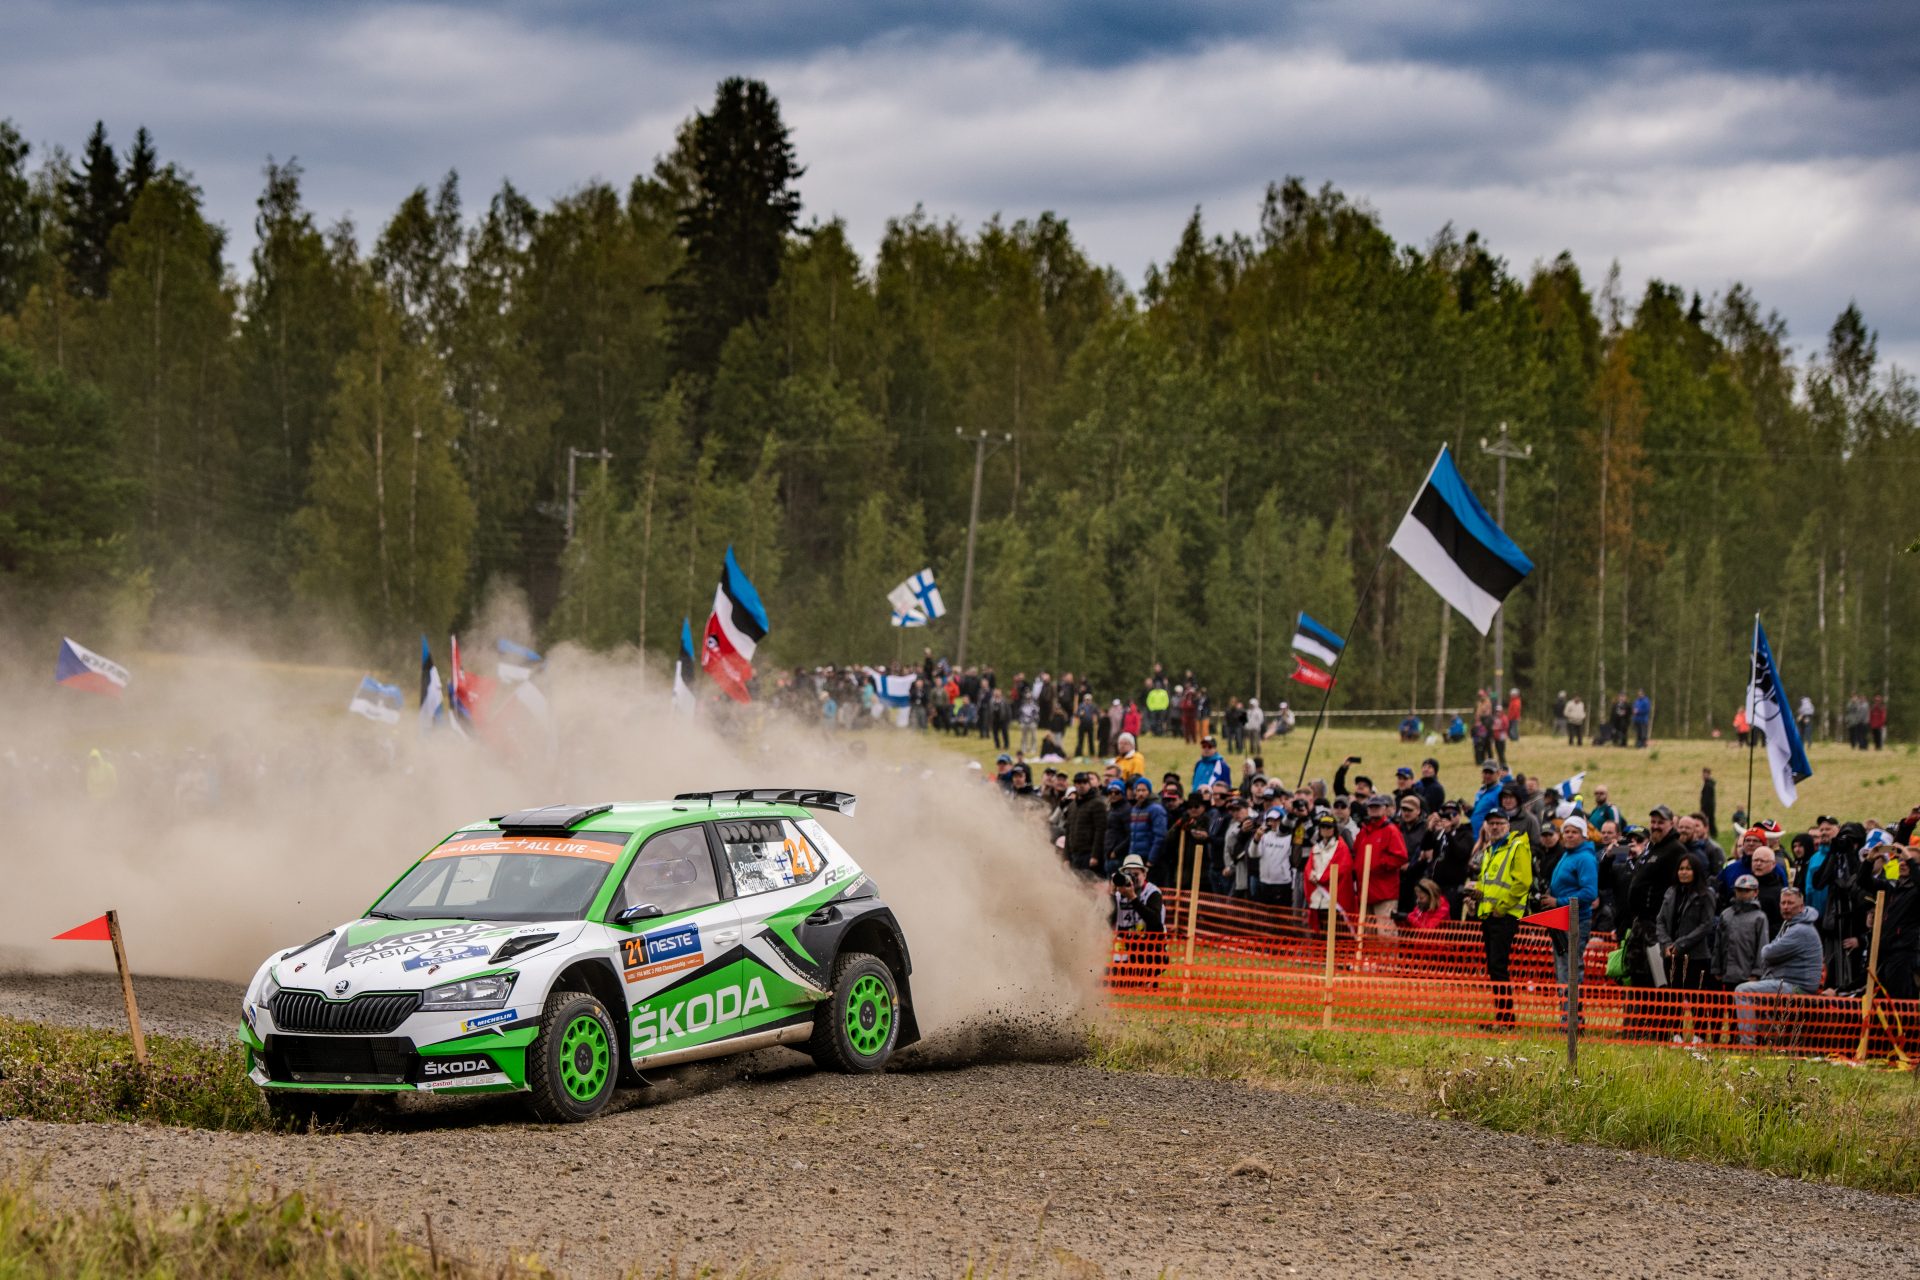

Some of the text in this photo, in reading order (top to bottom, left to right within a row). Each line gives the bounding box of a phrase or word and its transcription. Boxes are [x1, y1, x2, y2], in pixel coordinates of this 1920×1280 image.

[526, 841, 550, 851] ALL
[554, 843, 587, 854] LIVE
[783, 834, 817, 876] 21
[430, 949, 455, 958] 21
[625, 932, 693, 966] 21 NESTE
[349, 946, 420, 968] FABIA
[419, 952, 473, 967] NESTE
[477, 1013, 512, 1027] MICHELIN
[630, 976, 770, 1054] ŠKODA
[424, 1060, 490, 1075] ŠKODA
[432, 1080, 453, 1088] Castrol
